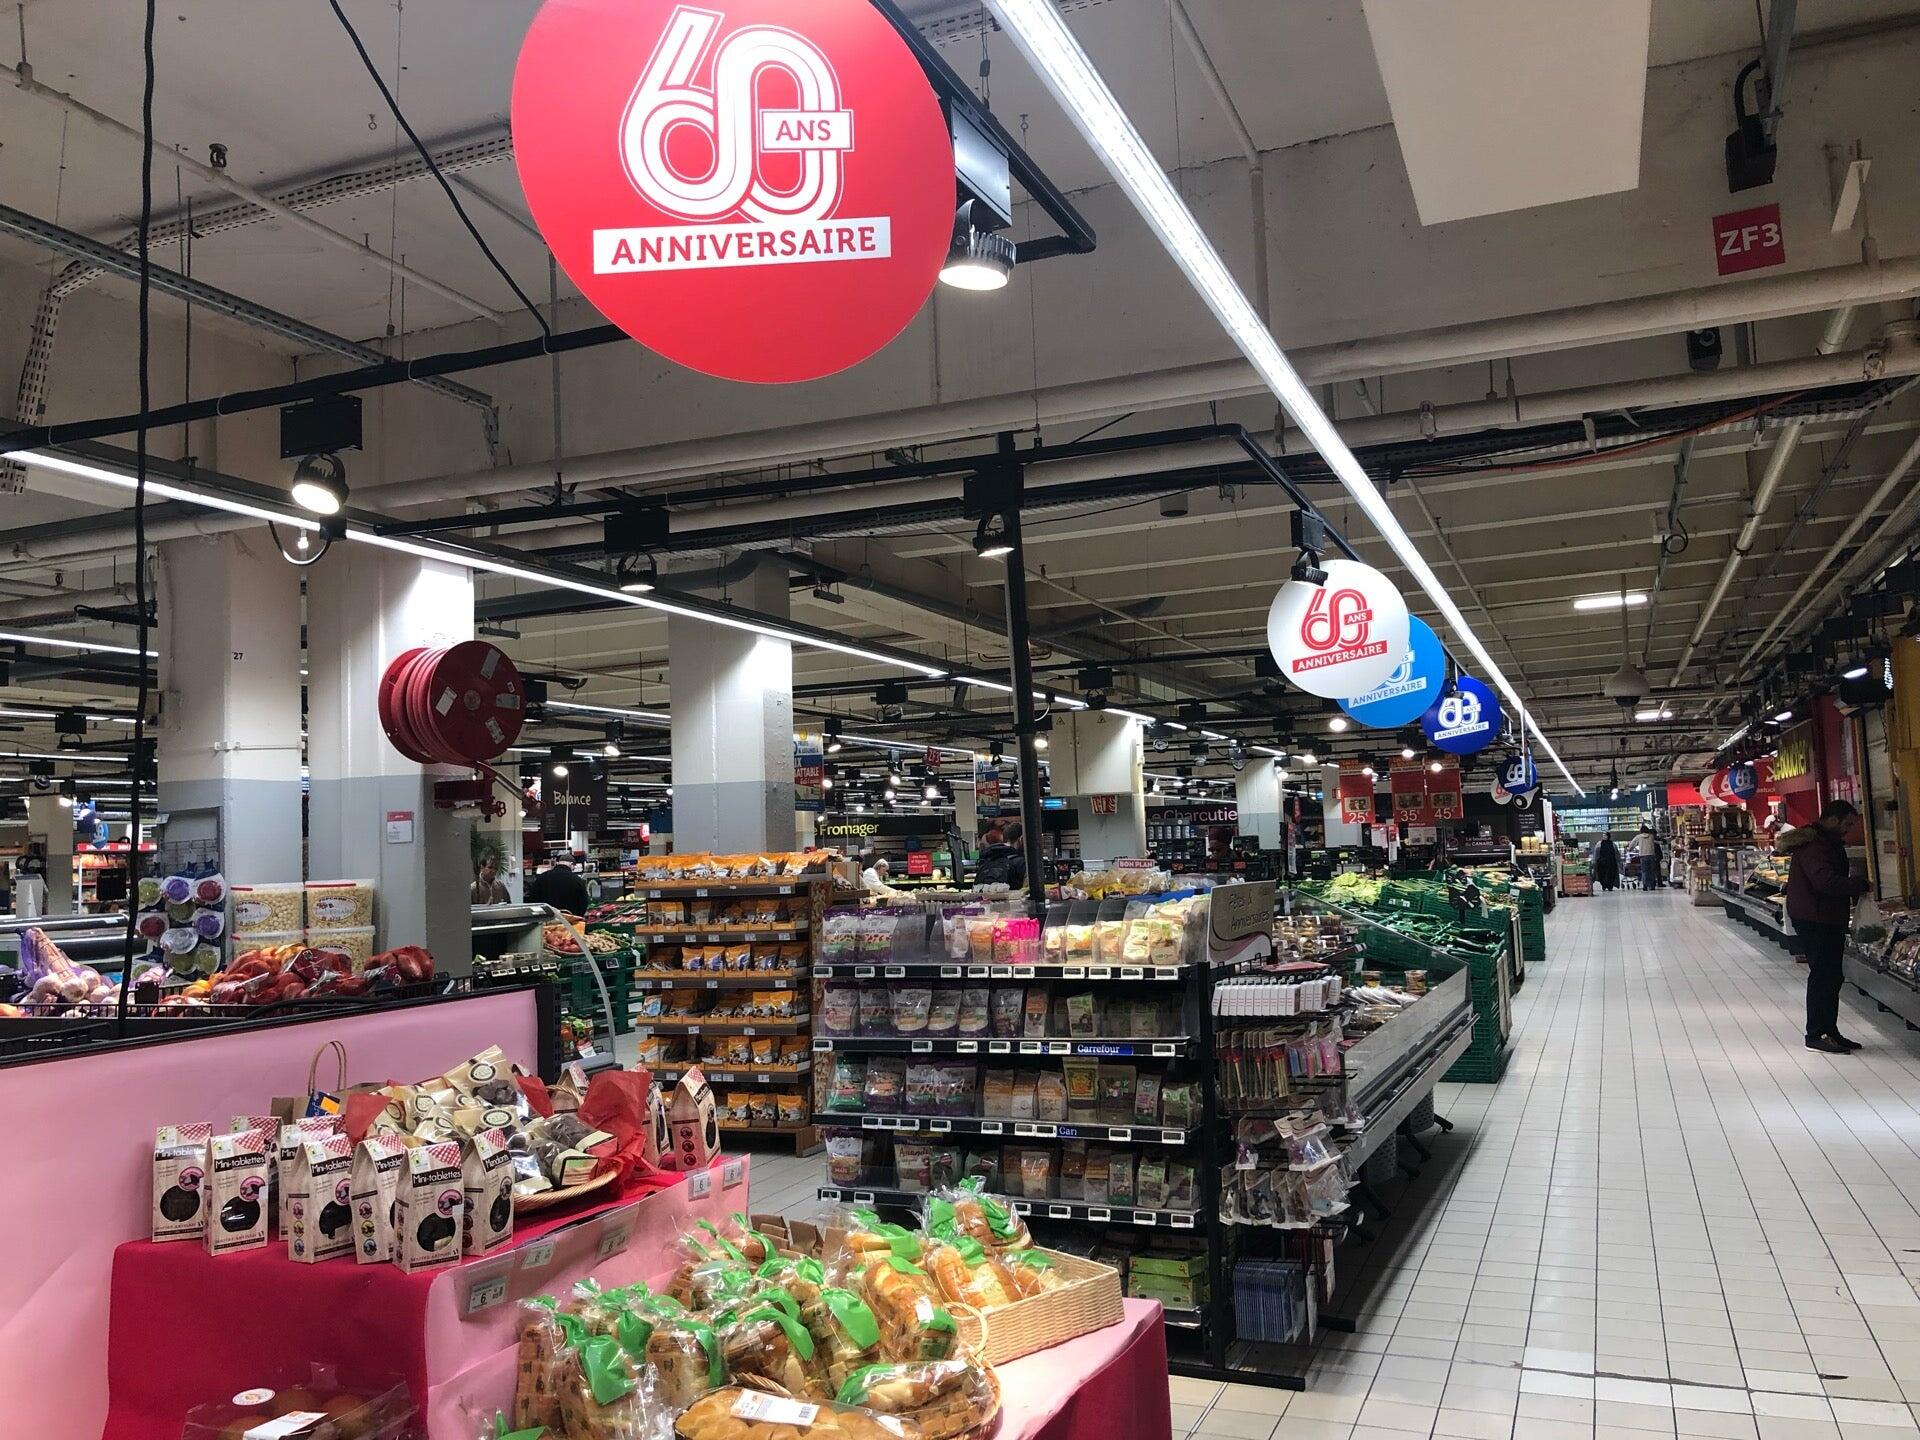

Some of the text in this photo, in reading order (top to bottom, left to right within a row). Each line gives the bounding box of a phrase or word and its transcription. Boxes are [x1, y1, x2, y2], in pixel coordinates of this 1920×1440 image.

[619, 4, 845, 223] 60
[775, 119, 832, 142] ANS
[611, 226, 877, 266] ANNIVERSAIRE
[1719, 222, 1781, 257] ZF3
[1300, 588, 1370, 651] 60
[1347, 612, 1368, 625] ANS
[233, 652, 244, 661] 27
[1297, 644, 1383, 672] ANNIVERSAIRE
[1352, 680, 1423, 706] ANNIVERSAIRE
[1437, 723, 1487, 739] ANNIVERSAIRE
[793, 767, 819, 778] ATTABLE
[553, 789, 592, 806] Balance
[1163, 806, 1238, 822] Charcutie
[820, 823, 880, 837] Fromager
[1077, 1044, 1120, 1054] Carrefour
[215, 1155, 266, 1170] Mini-tablettes
[413, 1171, 461, 1186] Mini-tablettes
[699, 1180, 704, 1191] 6
[480, 1292, 487, 1304] 6
